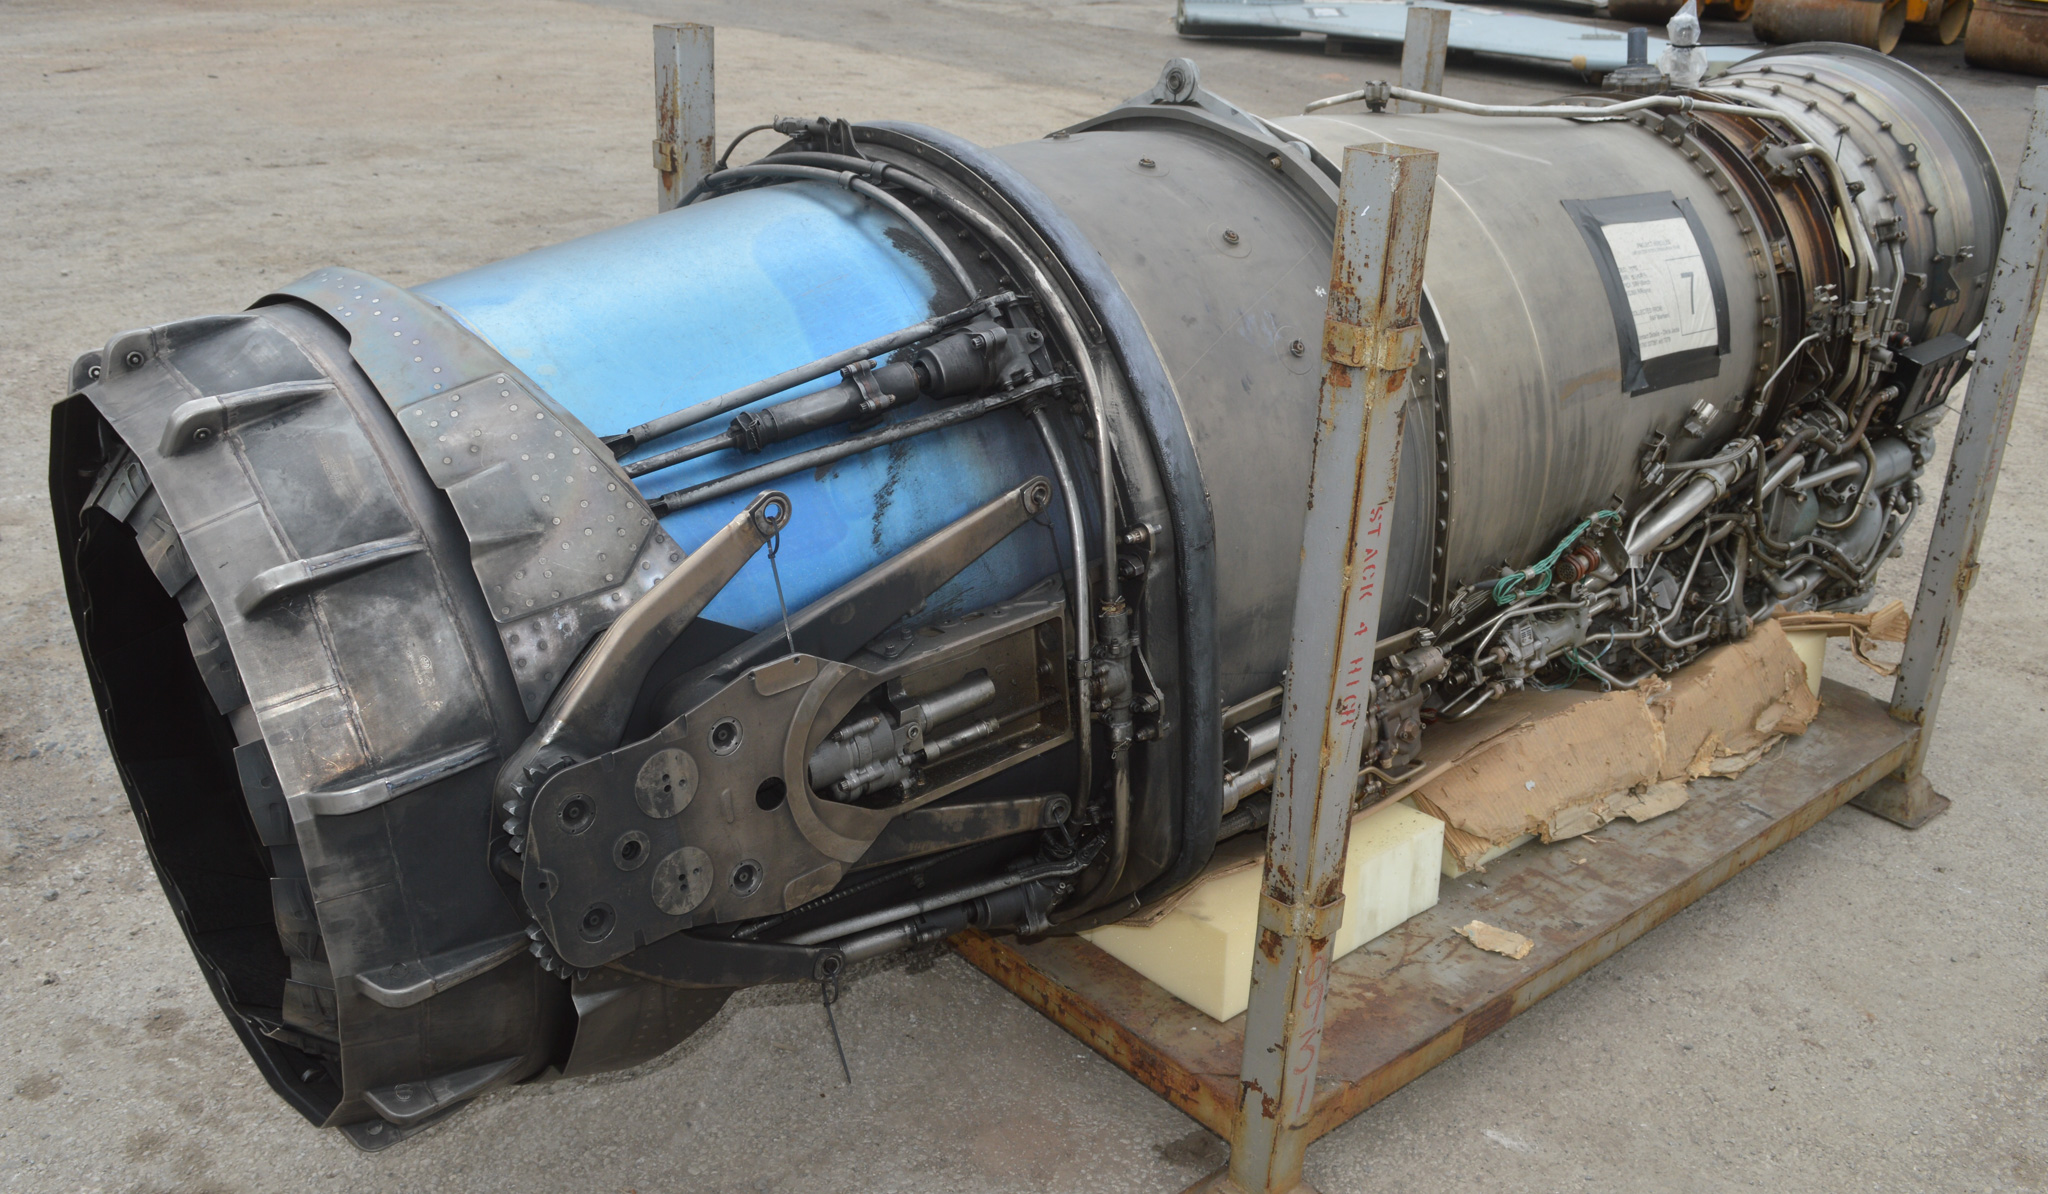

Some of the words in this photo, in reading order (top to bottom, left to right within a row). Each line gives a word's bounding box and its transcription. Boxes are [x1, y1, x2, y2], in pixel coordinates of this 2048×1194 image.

[1680, 271, 1695, 315] 7
[1359, 505, 1384, 601] STACK
[1353, 621, 1369, 637] 4
[1340, 656, 1364, 726] HIGH
